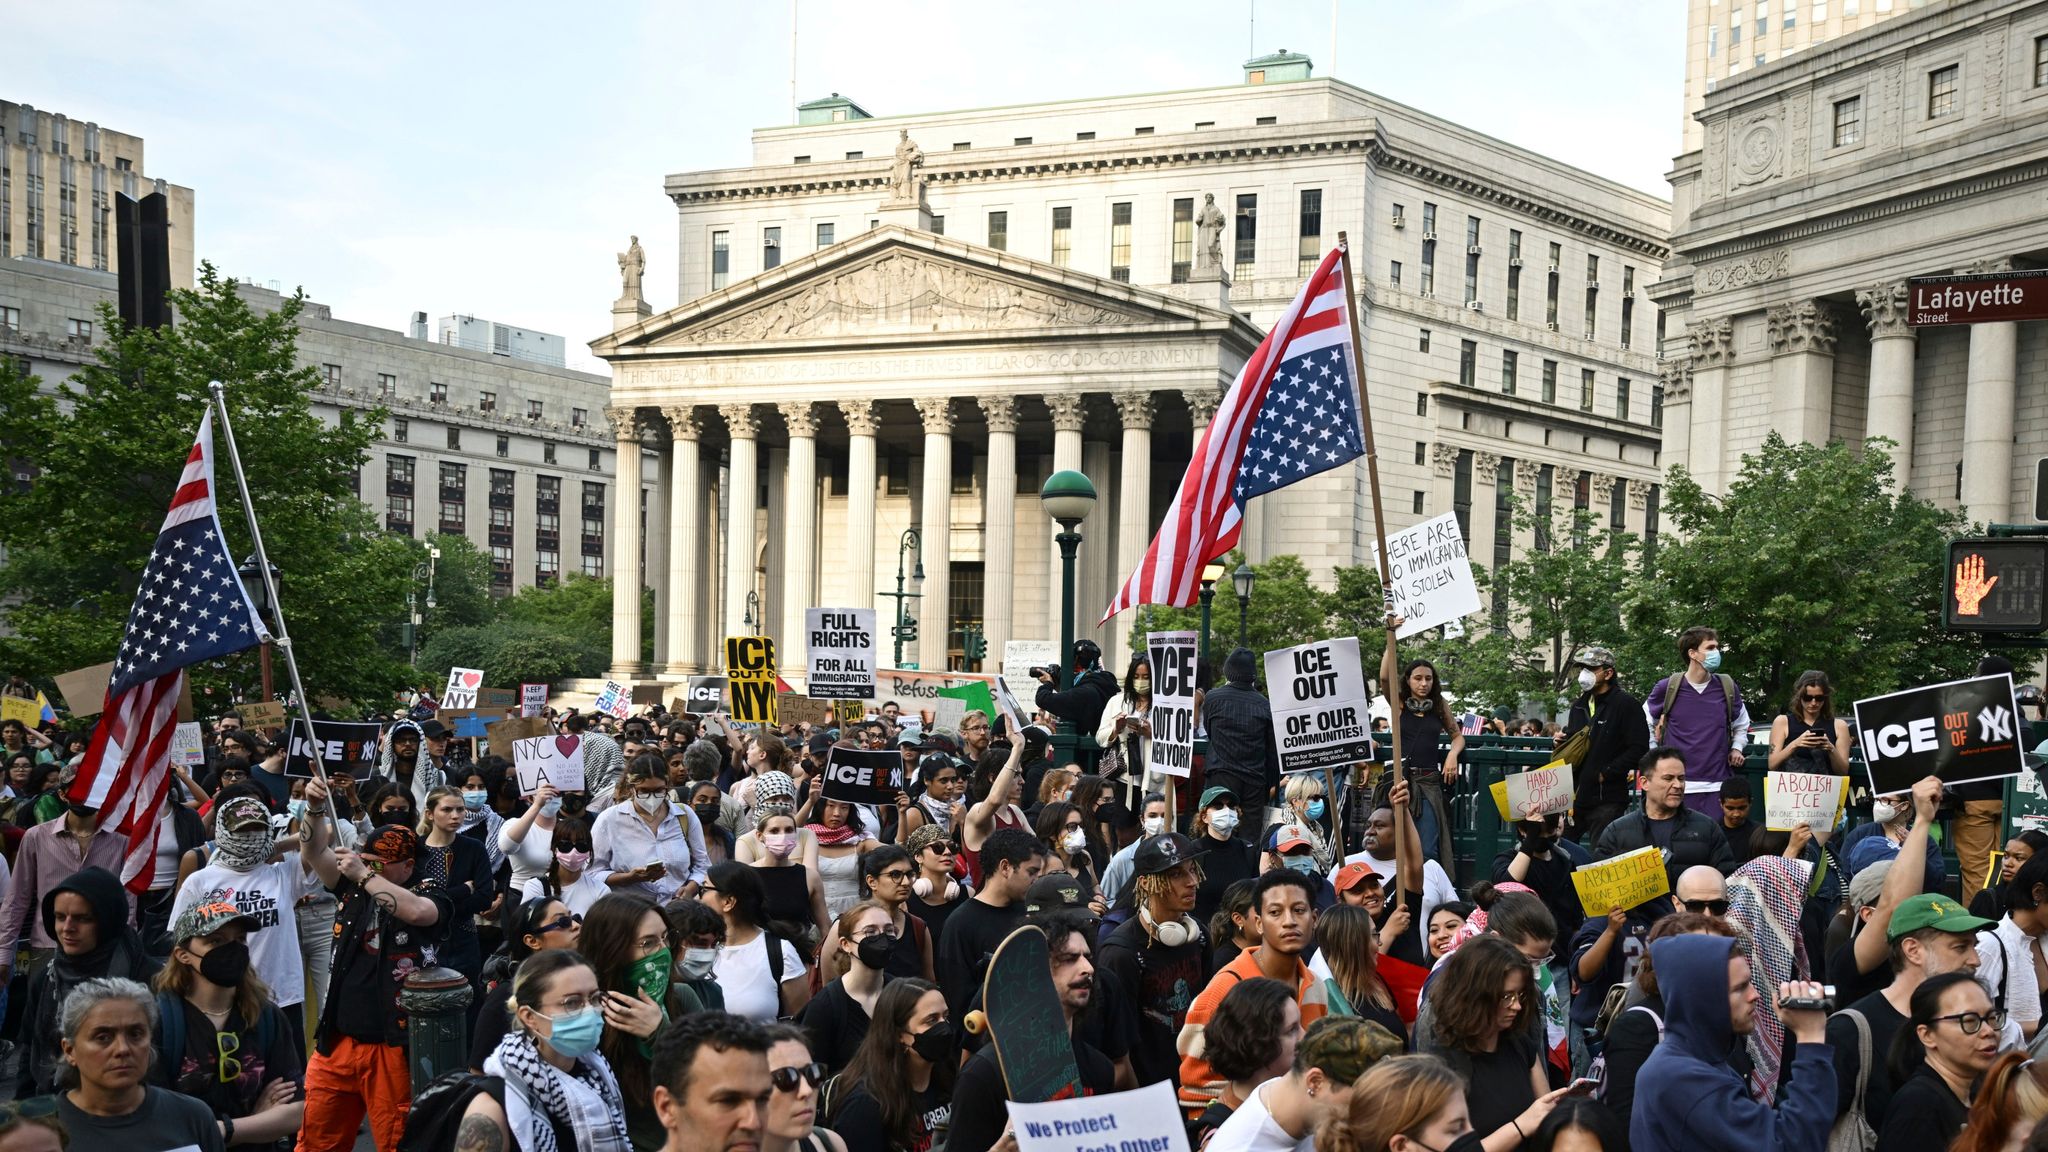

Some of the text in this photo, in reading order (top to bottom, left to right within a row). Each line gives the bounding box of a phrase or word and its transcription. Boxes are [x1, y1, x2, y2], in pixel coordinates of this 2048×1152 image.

[1917, 283, 2024, 312] Lafayette
[1916, 312, 1949, 324] Street
[624, 370, 645, 384] THE
[650, 369, 679, 383] TRUE
[1099, 348, 1204, 365] GOVERNMENT
[1427, 520, 1456, 546] ARE
[1408, 539, 1466, 574] IMMIGRANTS
[1411, 566, 1455, 597] STOLEN
[821, 613, 861, 630] FULL
[1403, 602, 1429, 620] AND.
[811, 631, 870, 648] RIGHTS
[727, 638, 775, 670] ICE
[816, 658, 867, 672] FOR ALL
[1293, 646, 1332, 675] ICE
[451, 671, 463, 687] I
[728, 670, 764, 679] OUT
[812, 673, 871, 683] IMMIGRANTS!
[1150, 646, 1195, 697] ICE
[689, 687, 720, 700] ICE
[1293, 672, 1338, 701] OUT
[445, 692, 475, 709] NY
[730, 681, 776, 722] NYC
[783, 698, 819, 710] FUCK
[1152, 705, 1192, 743] OUT OF
[1286, 707, 1357, 735] OF OUR
[1283, 725, 1364, 749] COMMUNITIES!
[1863, 704, 2014, 762] ICE OUT NY
[1951, 730, 1968, 747] OF
[292, 737, 345, 760] ICE
[514, 737, 553, 762] NYC
[1152, 741, 1191, 769] NEW YORK
[1285, 754, 1299, 762] Party
[1308, 750, 1333, 758] Socialism
[827, 763, 873, 786] ICE
[876, 768, 888, 777] OUT
[1286, 759, 1313, 767] Liberation
[519, 767, 550, 792] LA
[1525, 769, 1558, 790] HANDS
[1777, 773, 1832, 793] ABOLISH
[1530, 785, 1552, 803] OFF
[1792, 793, 1820, 809] ICE
[1584, 851, 1661, 889] ABOLISH ICE
[235, 890, 265, 903] U.S.
[1581, 873, 1664, 904] NO ONE IS ILLEGAL
[1591, 902, 1607, 912] ON
[1639, 883, 1659, 898] LAND
[236, 898, 276, 913] OUT OF
[1025, 1113, 1118, 1138] We Protect
[1120, 1136, 1169, 1152] Other
